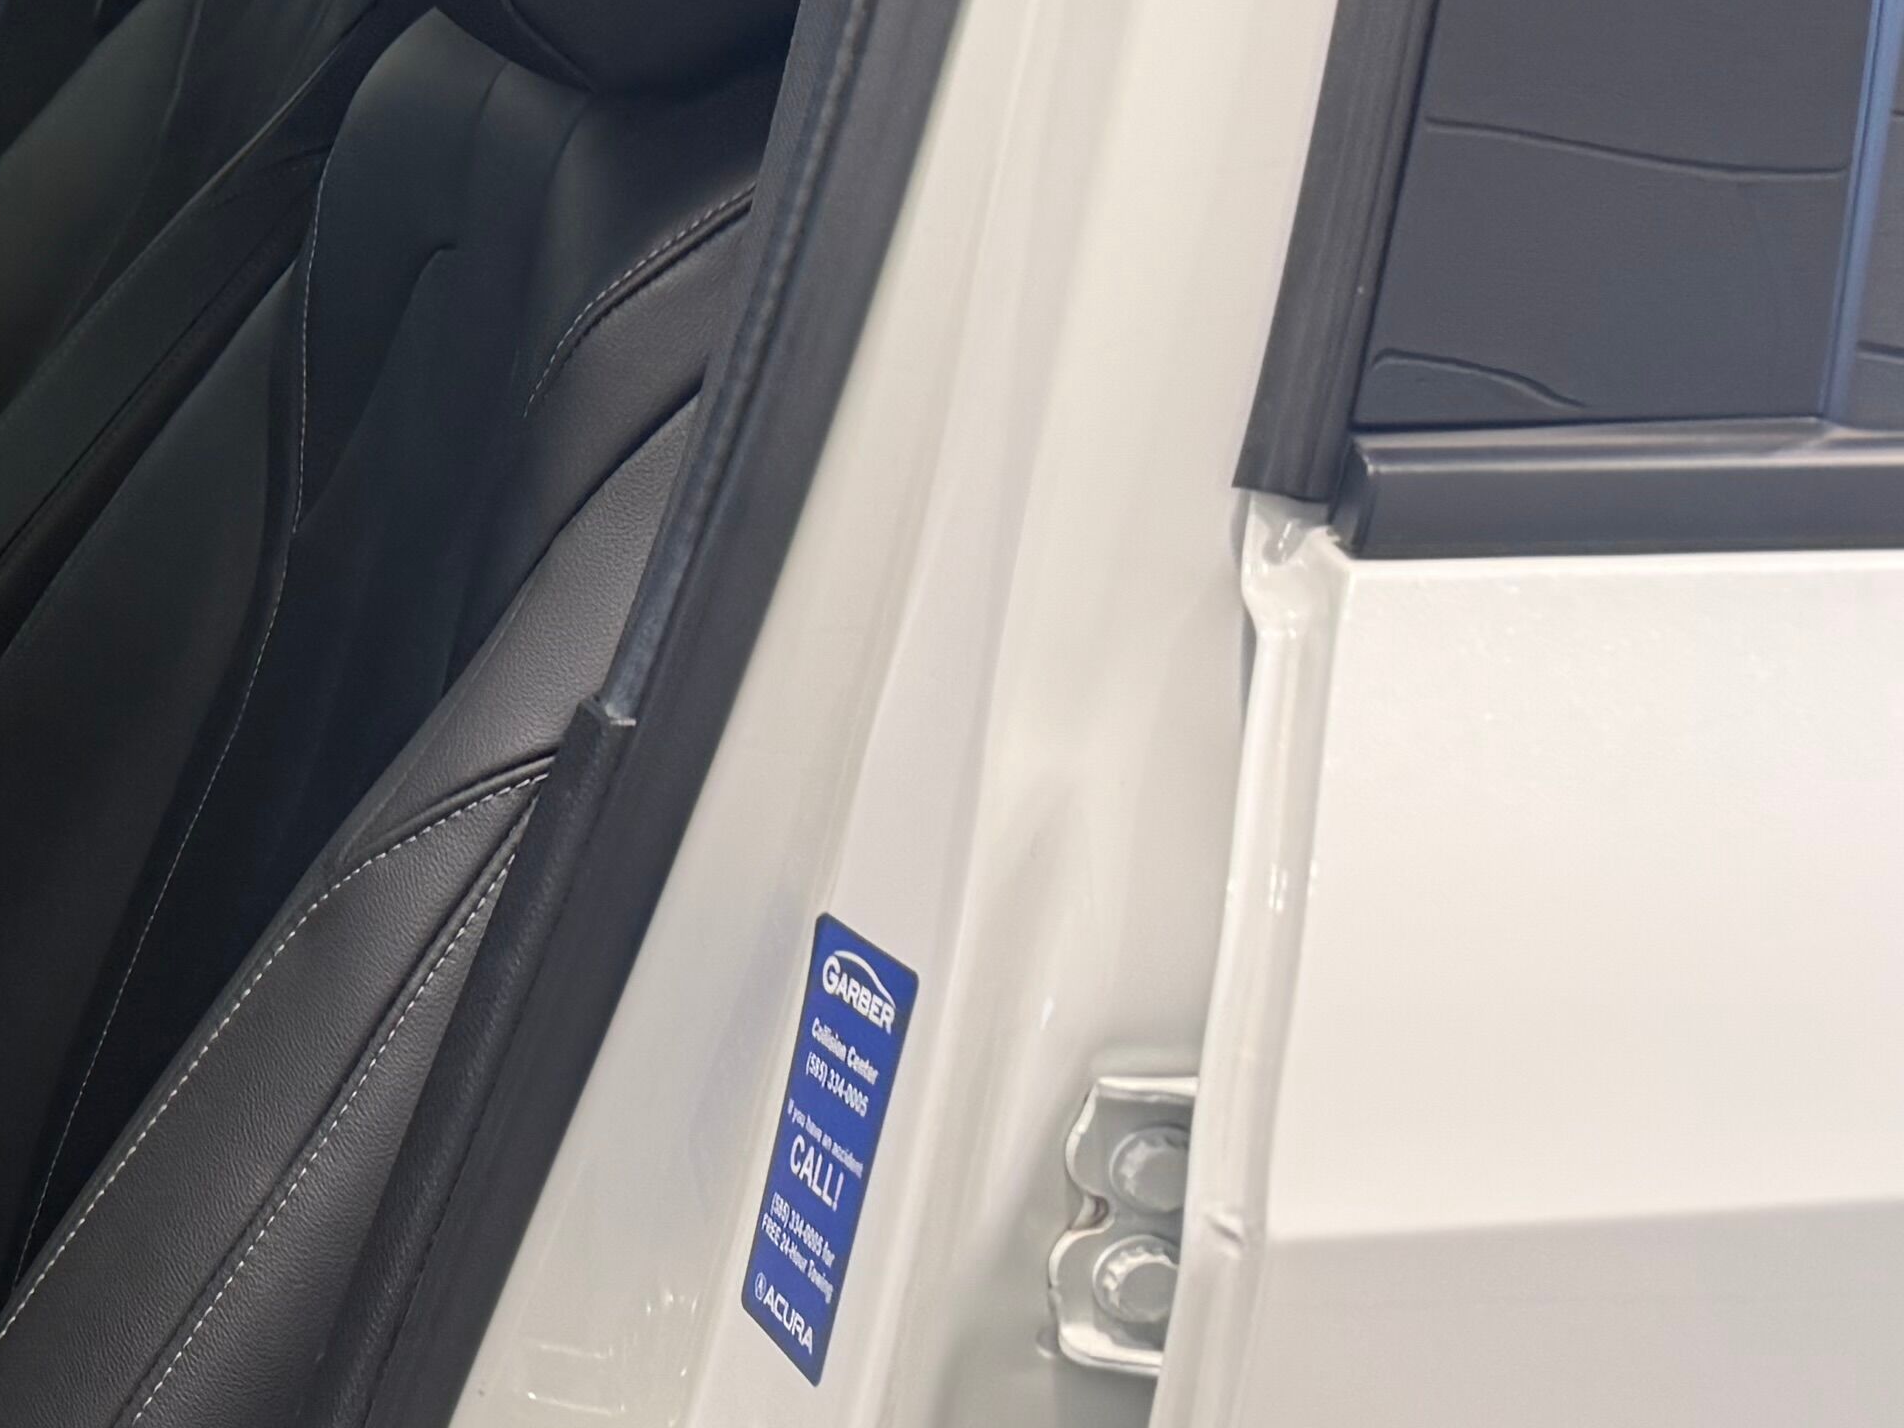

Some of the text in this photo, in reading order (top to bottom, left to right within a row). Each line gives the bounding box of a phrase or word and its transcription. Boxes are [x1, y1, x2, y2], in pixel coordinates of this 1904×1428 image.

[820, 954, 899, 1036] GARBER
[810, 1016, 880, 1087] Collision Center
[787, 1131, 845, 1212] CALL!
[791, 1106, 806, 1130] you
[804, 1115, 823, 1142] have
[830, 1137, 864, 1179] accident
[761, 1211, 835, 1306] FREE 24-Hour Towing
[821, 1240, 836, 1269] for
[763, 1281, 817, 1355] ACURA
